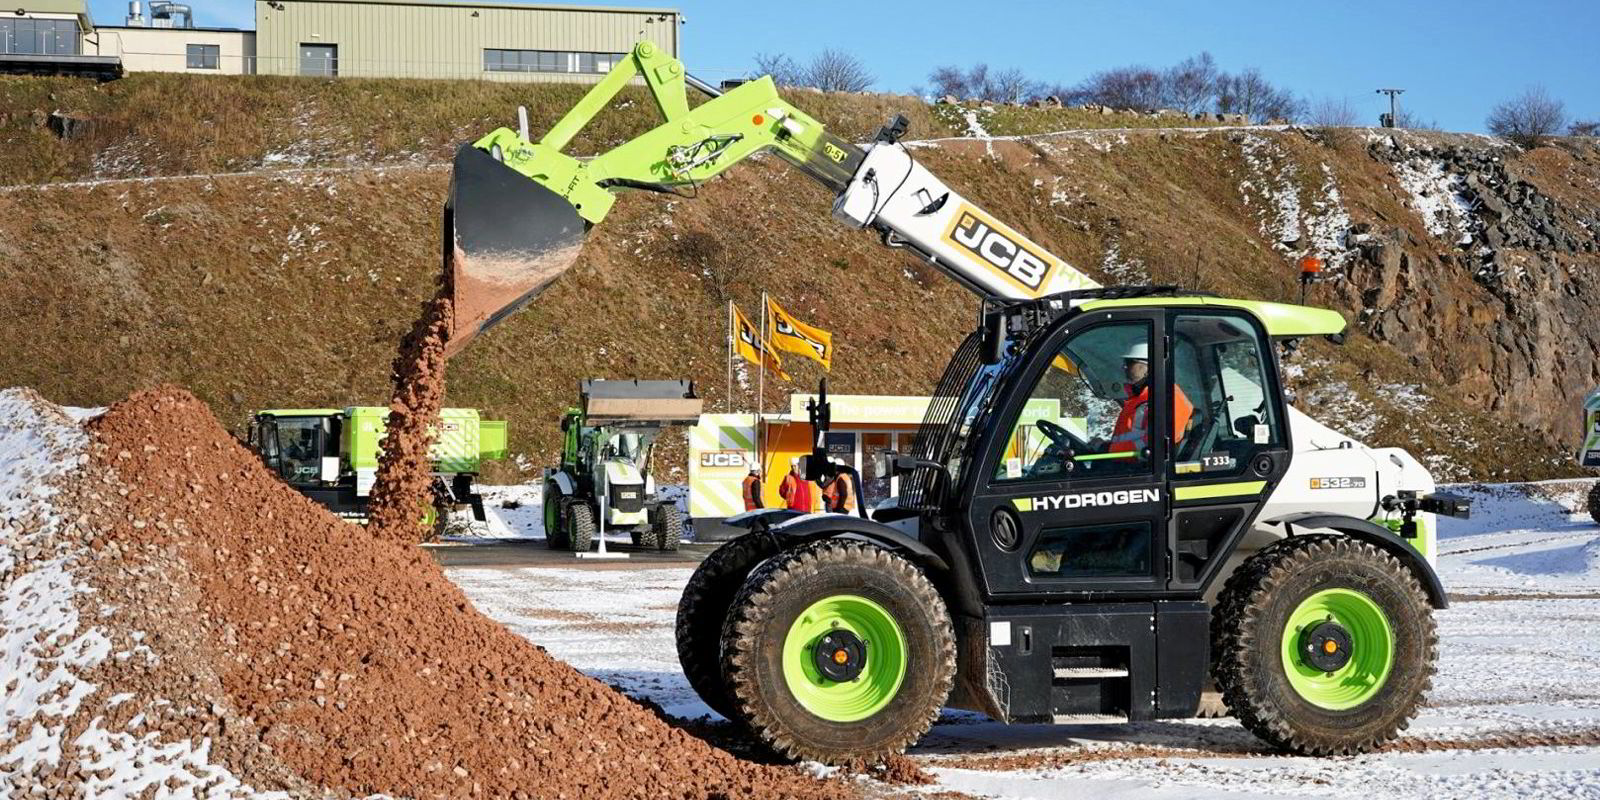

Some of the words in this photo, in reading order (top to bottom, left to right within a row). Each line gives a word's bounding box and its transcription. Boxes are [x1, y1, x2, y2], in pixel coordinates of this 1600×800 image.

[954, 223, 1047, 289] JCB
[701, 453, 744, 466] JCB
[1202, 457, 1211, 466] T
[1212, 455, 1230, 465] 333
[295, 466, 318, 474] JCB
[1032, 488, 1160, 511] HYDROGEN
